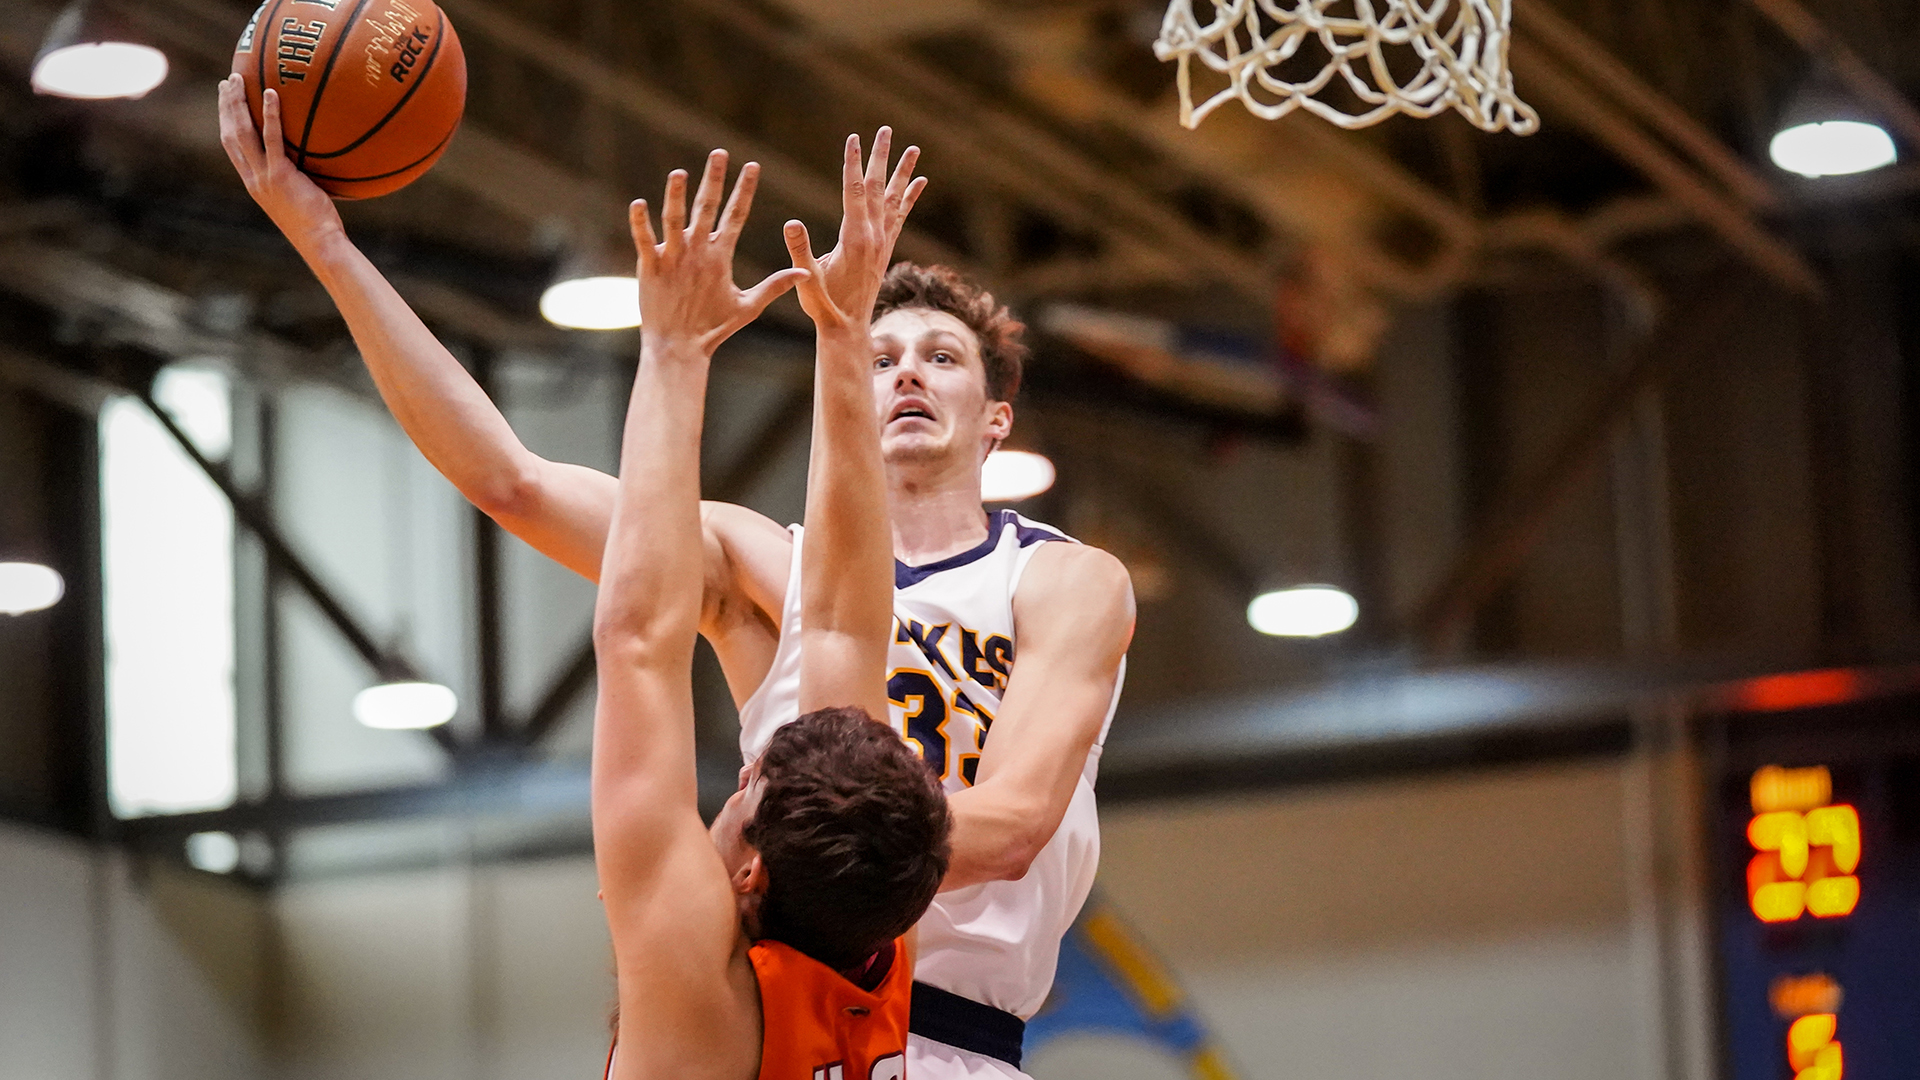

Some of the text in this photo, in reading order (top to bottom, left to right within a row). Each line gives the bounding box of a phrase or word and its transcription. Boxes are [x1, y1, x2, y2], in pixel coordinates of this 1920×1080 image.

[277, 17, 328, 86] THE
[390, 25, 429, 84] ROCK
[894, 617, 1013, 690] KES
